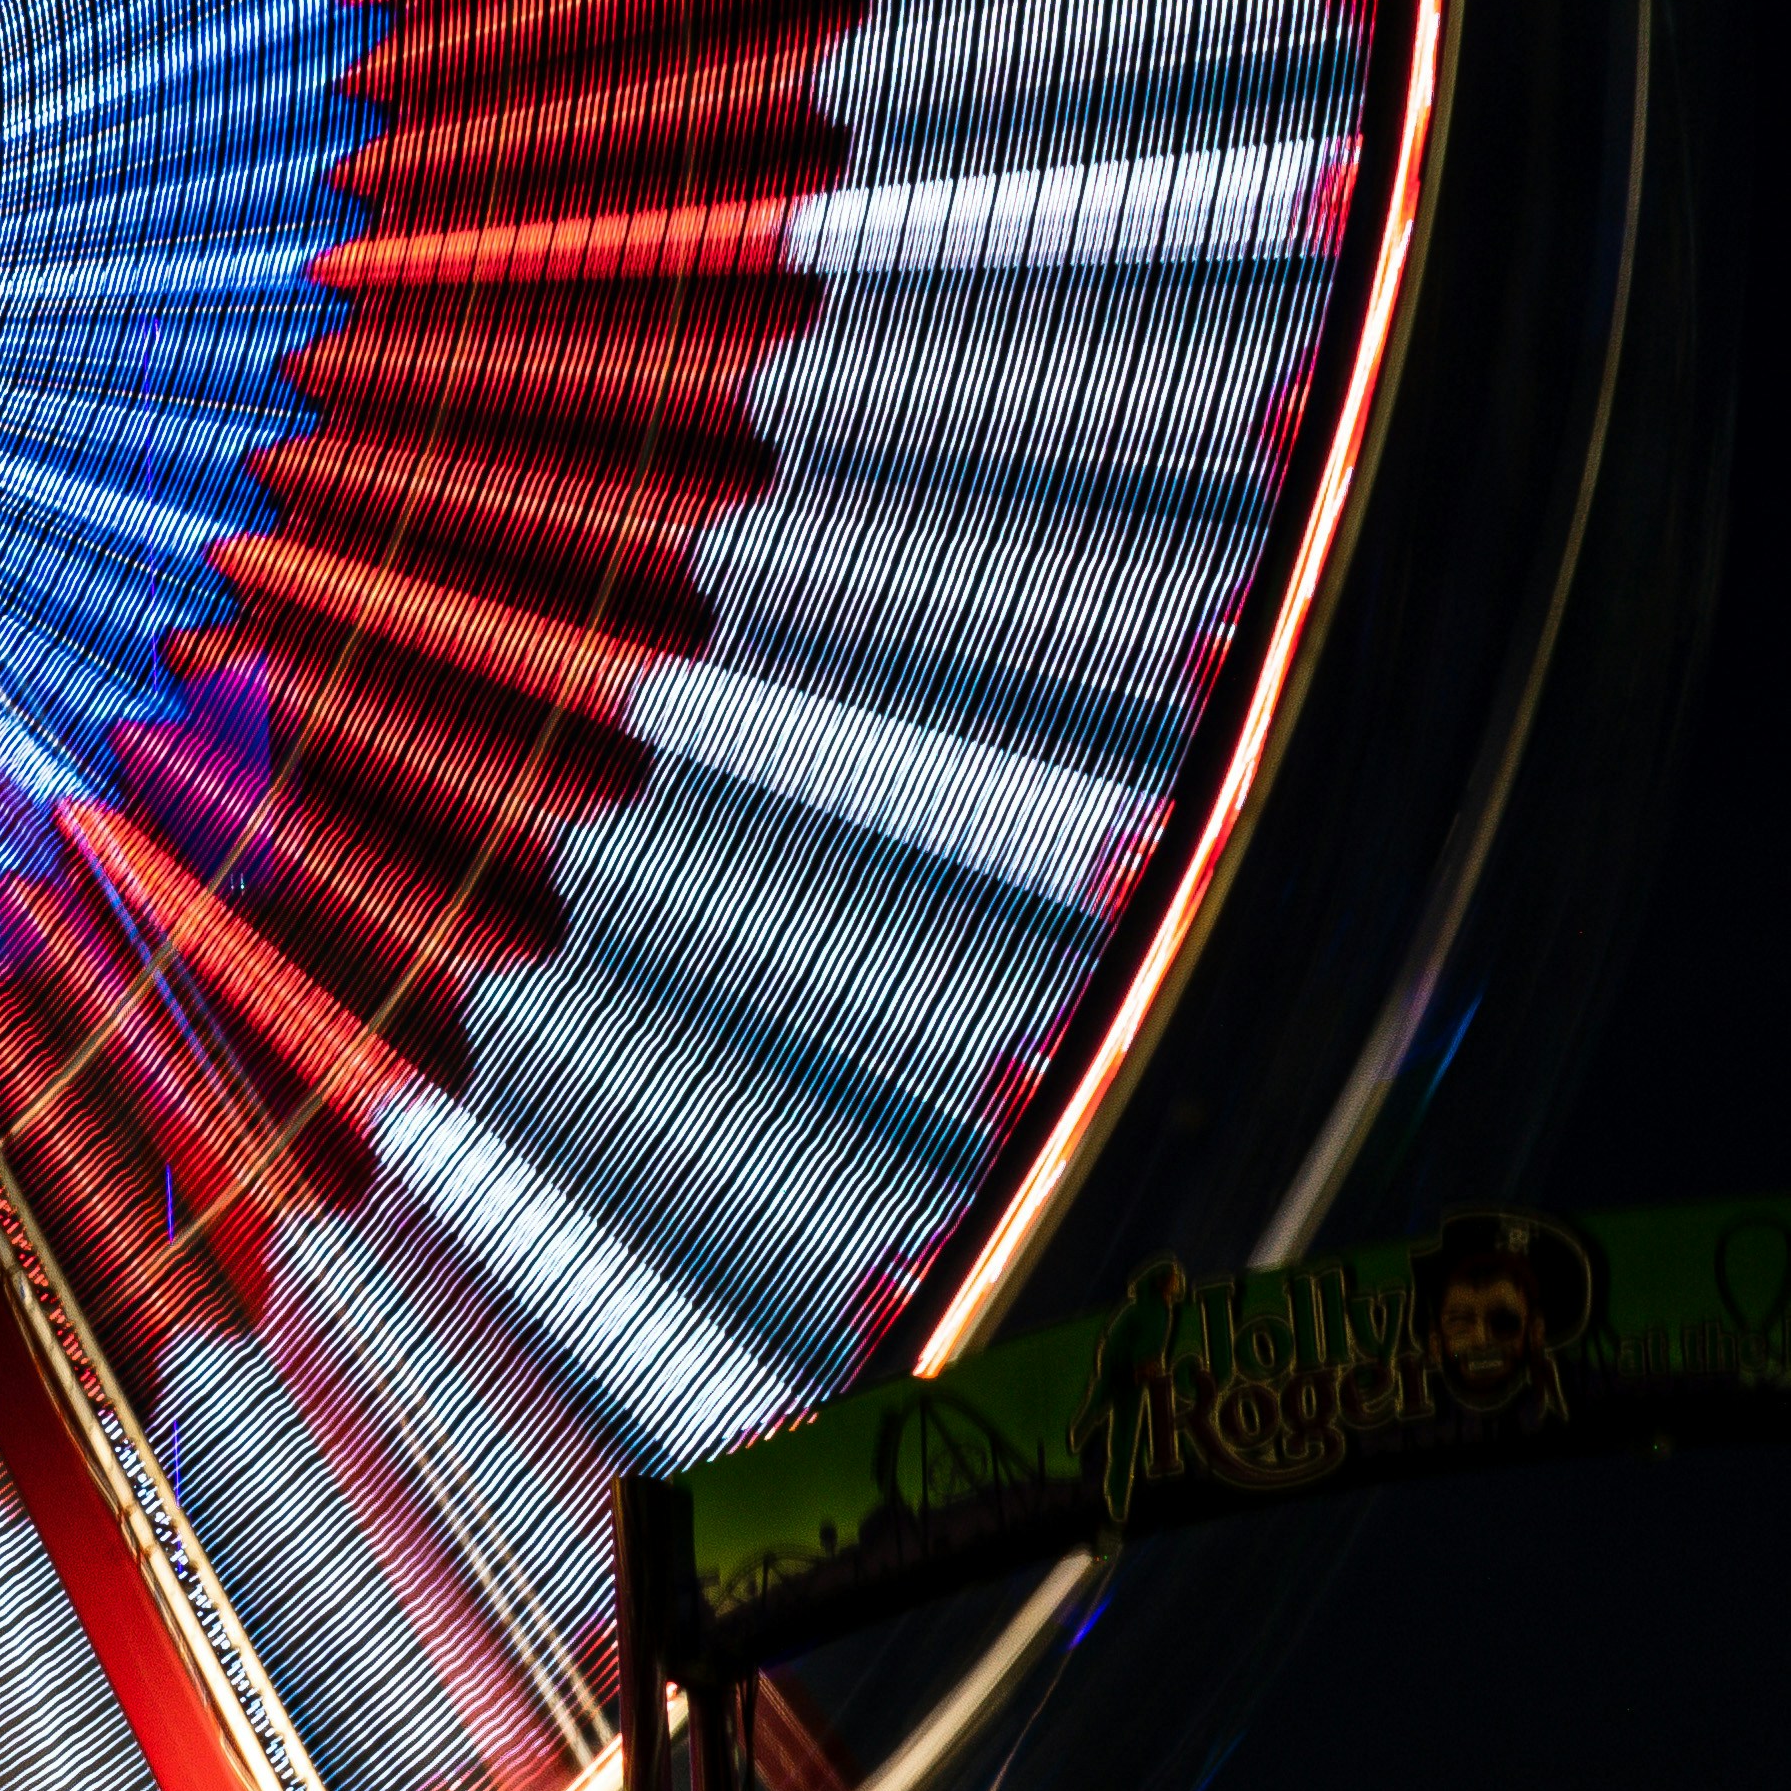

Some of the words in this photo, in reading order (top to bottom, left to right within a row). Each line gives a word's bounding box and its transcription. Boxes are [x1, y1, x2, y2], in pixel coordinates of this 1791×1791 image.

[1171, 1255, 1408, 1380] Jolly
[1682, 1317, 1767, 1375] the
[1144, 1358, 1443, 1491] Roger
